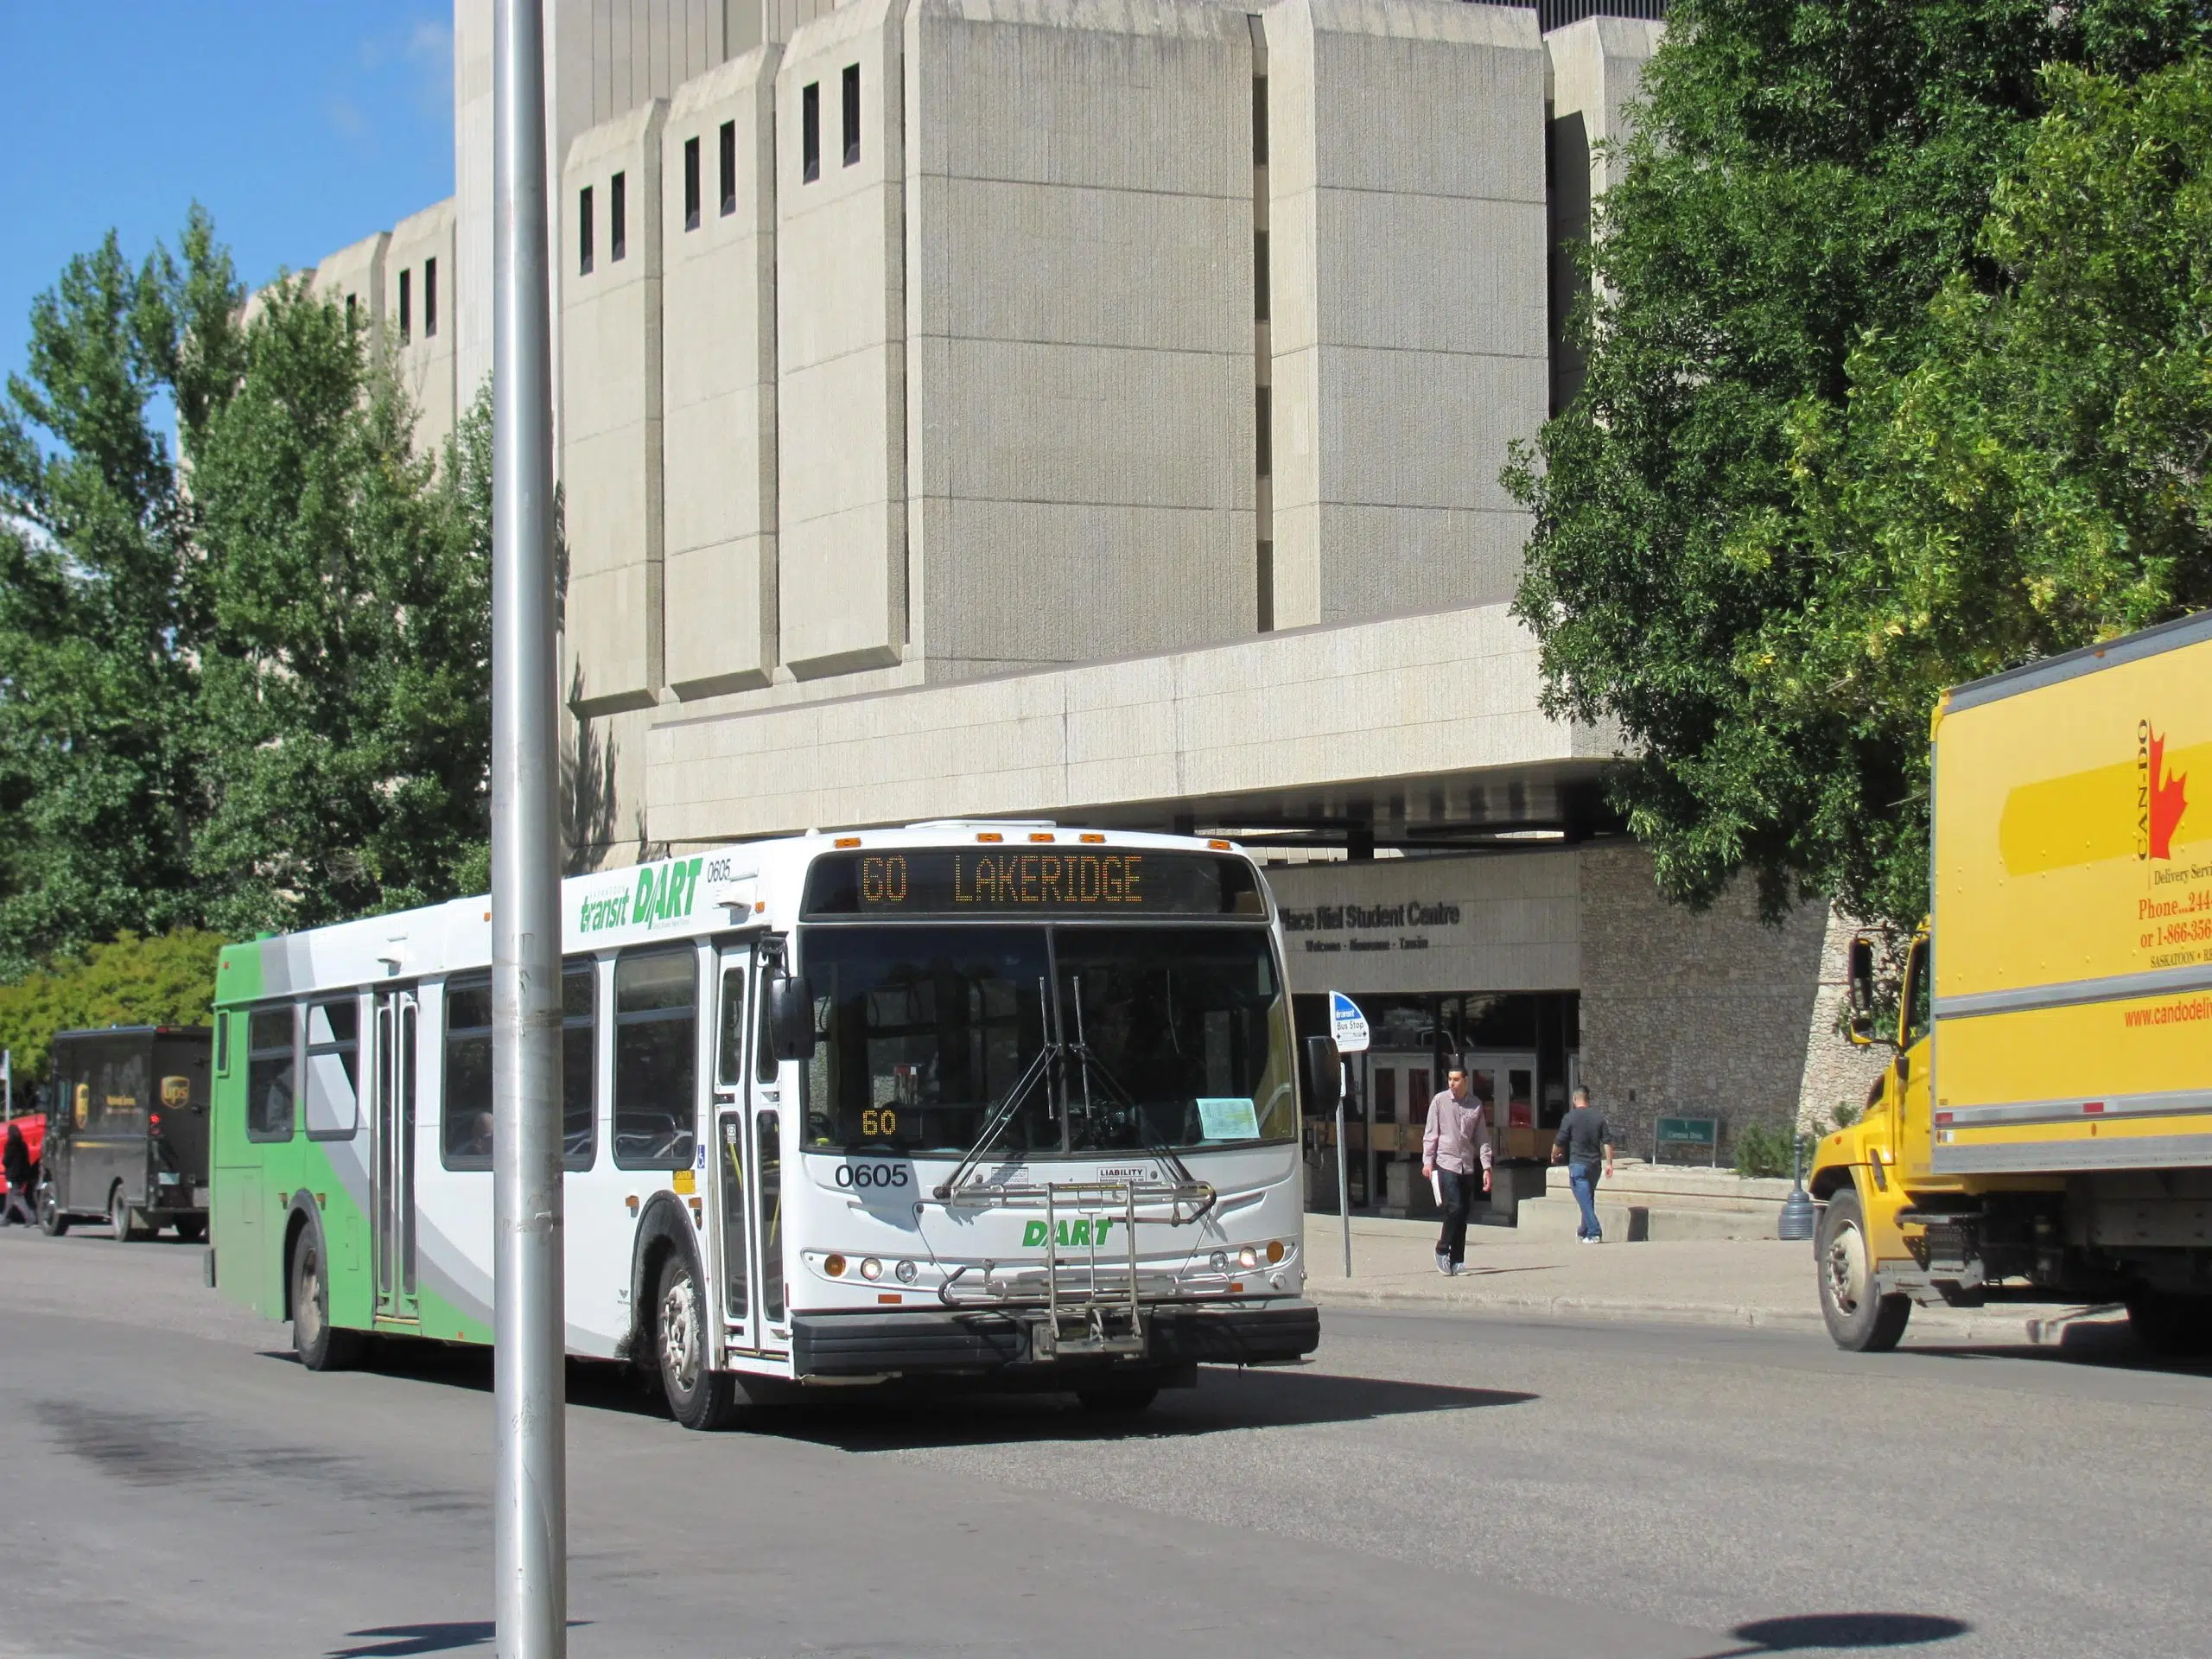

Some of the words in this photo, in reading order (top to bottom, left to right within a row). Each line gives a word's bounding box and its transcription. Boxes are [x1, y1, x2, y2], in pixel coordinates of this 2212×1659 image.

[707, 858, 731, 883] 0605
[863, 855, 906, 902] 60
[955, 855, 1142, 902] LAKERIDGE
[2154, 868, 2190, 886] Delivery
[580, 887, 630, 933] transit
[632, 857, 703, 928] DART
[1345, 903, 1404, 929] Student
[1407, 900, 1460, 926] Centre
[2140, 933, 2153, 948] or
[2150, 950, 2196, 969] SASKATOON
[1337, 1021, 1348, 1030] Bus
[1349, 1020, 1364, 1030] Stop
[862, 1109, 896, 1135] 60
[835, 1164, 909, 1188] 0605
[1021, 1218, 1114, 1249] DART
